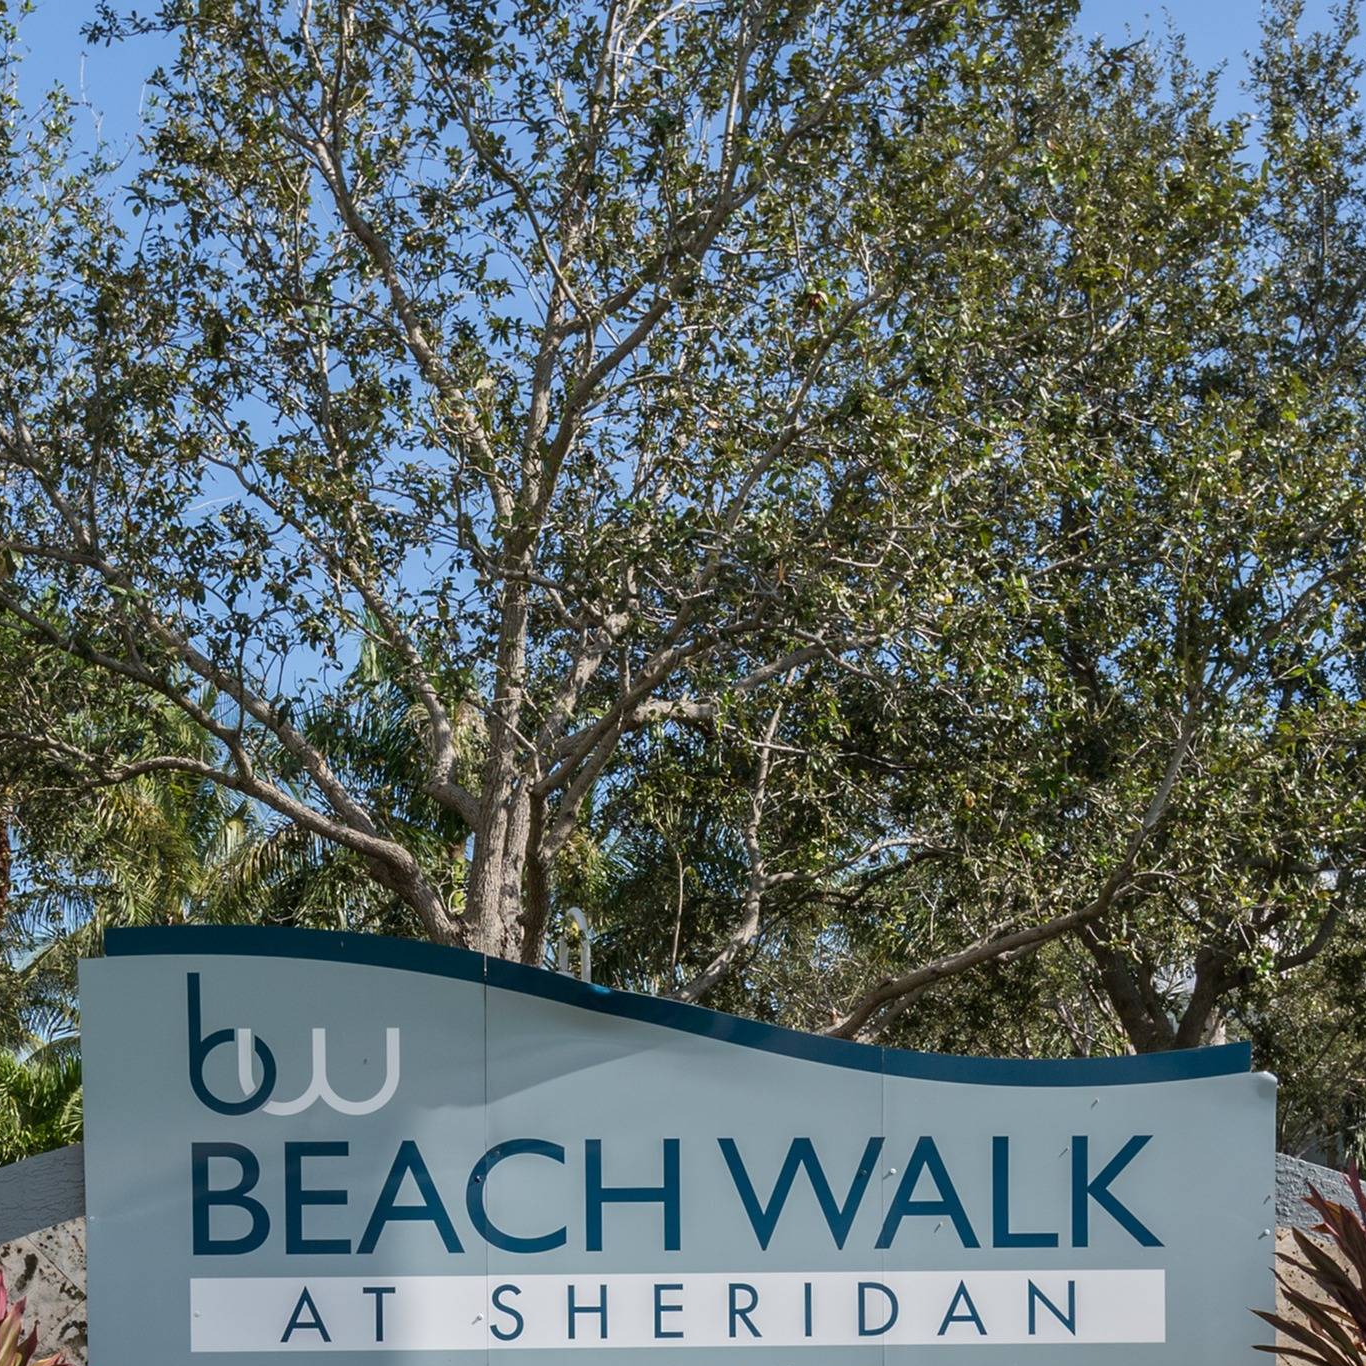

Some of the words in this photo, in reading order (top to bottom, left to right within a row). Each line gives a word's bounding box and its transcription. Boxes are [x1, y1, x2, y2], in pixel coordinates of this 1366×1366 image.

[191, 1138, 681, 1256] BEACH
[717, 1134, 1165, 1251] WALK
[280, 1286, 396, 1343] AT
[489, 1279, 1076, 1341] SHERIDAN
